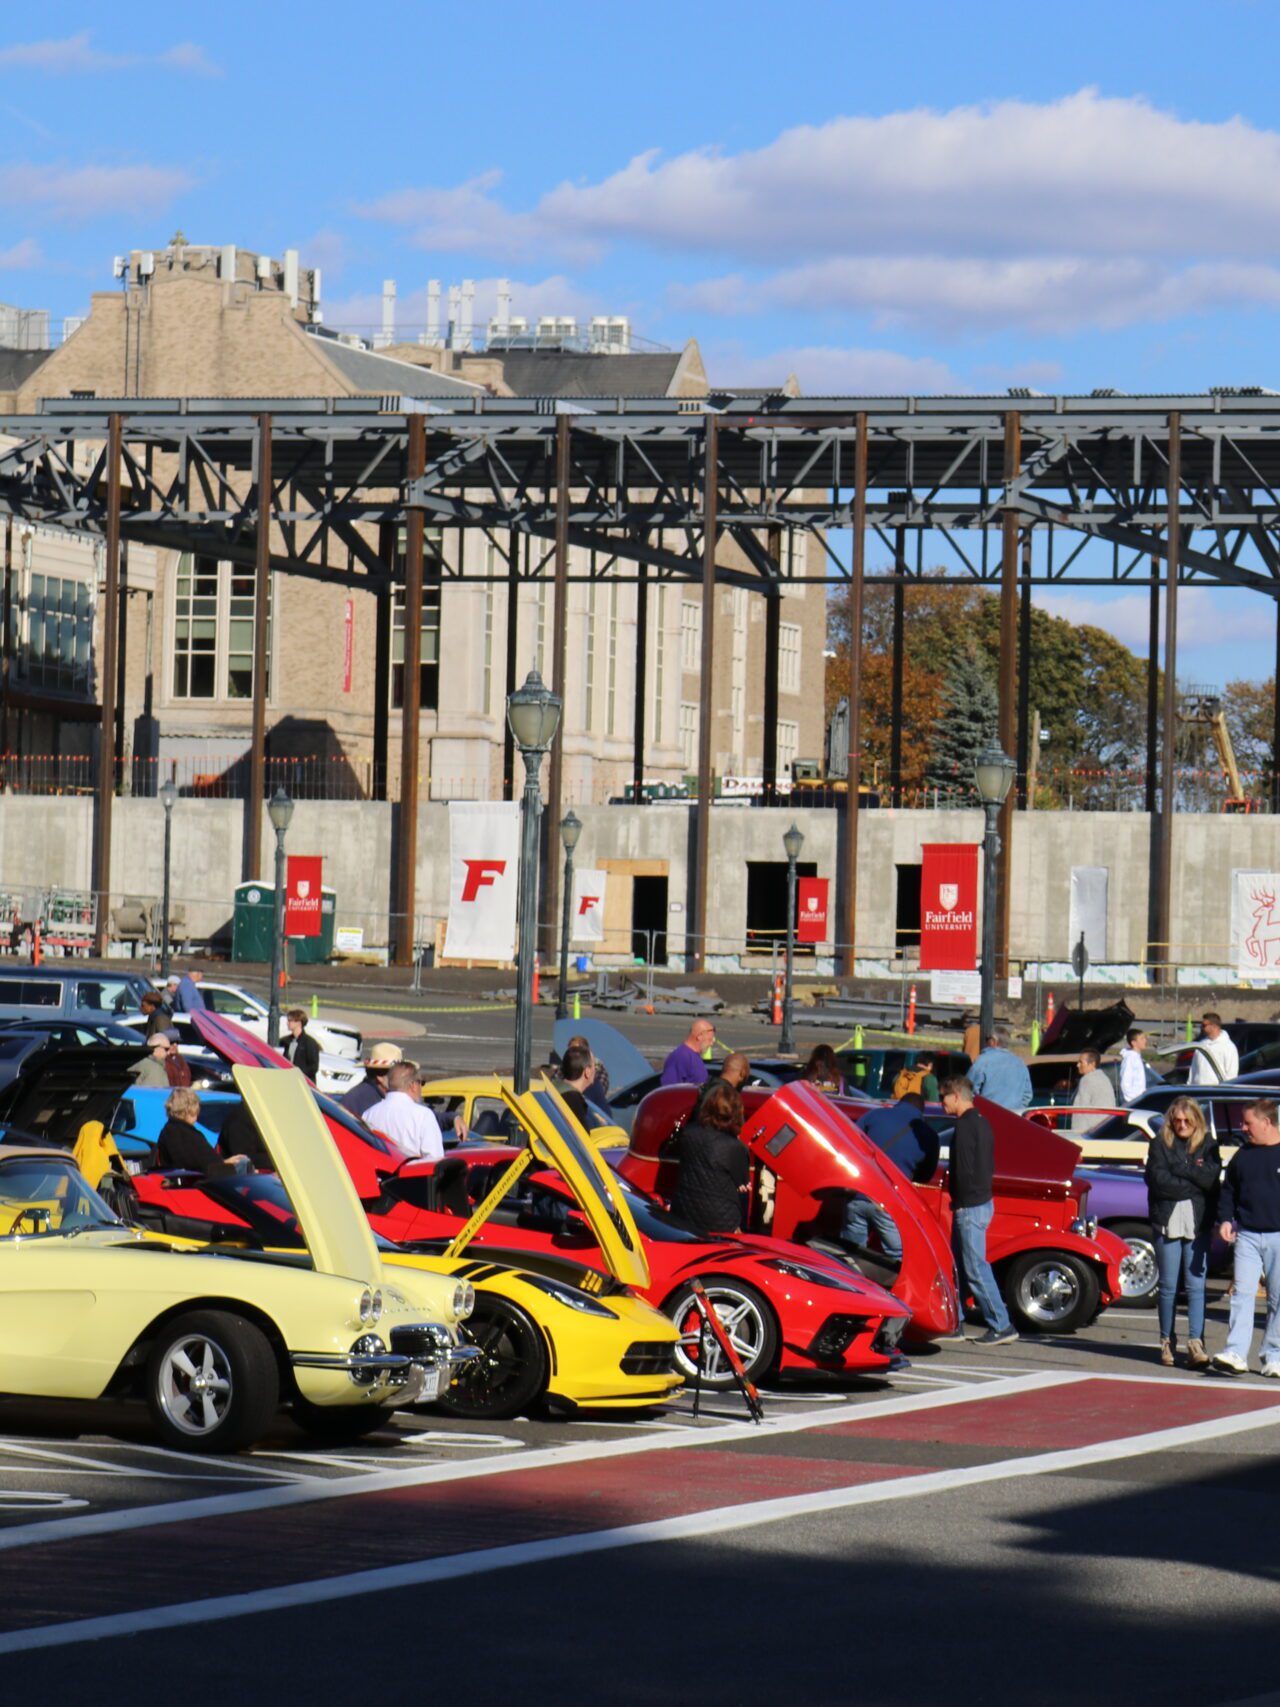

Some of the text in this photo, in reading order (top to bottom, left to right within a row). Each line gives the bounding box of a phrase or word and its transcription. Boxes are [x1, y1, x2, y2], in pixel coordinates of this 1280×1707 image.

[461, 859, 507, 902] F
[287, 898, 319, 906] Fairfield
[578, 896, 600, 915] F
[925, 911, 973, 923] Fairfield
[925, 923, 973, 931] UNIVERSITY
